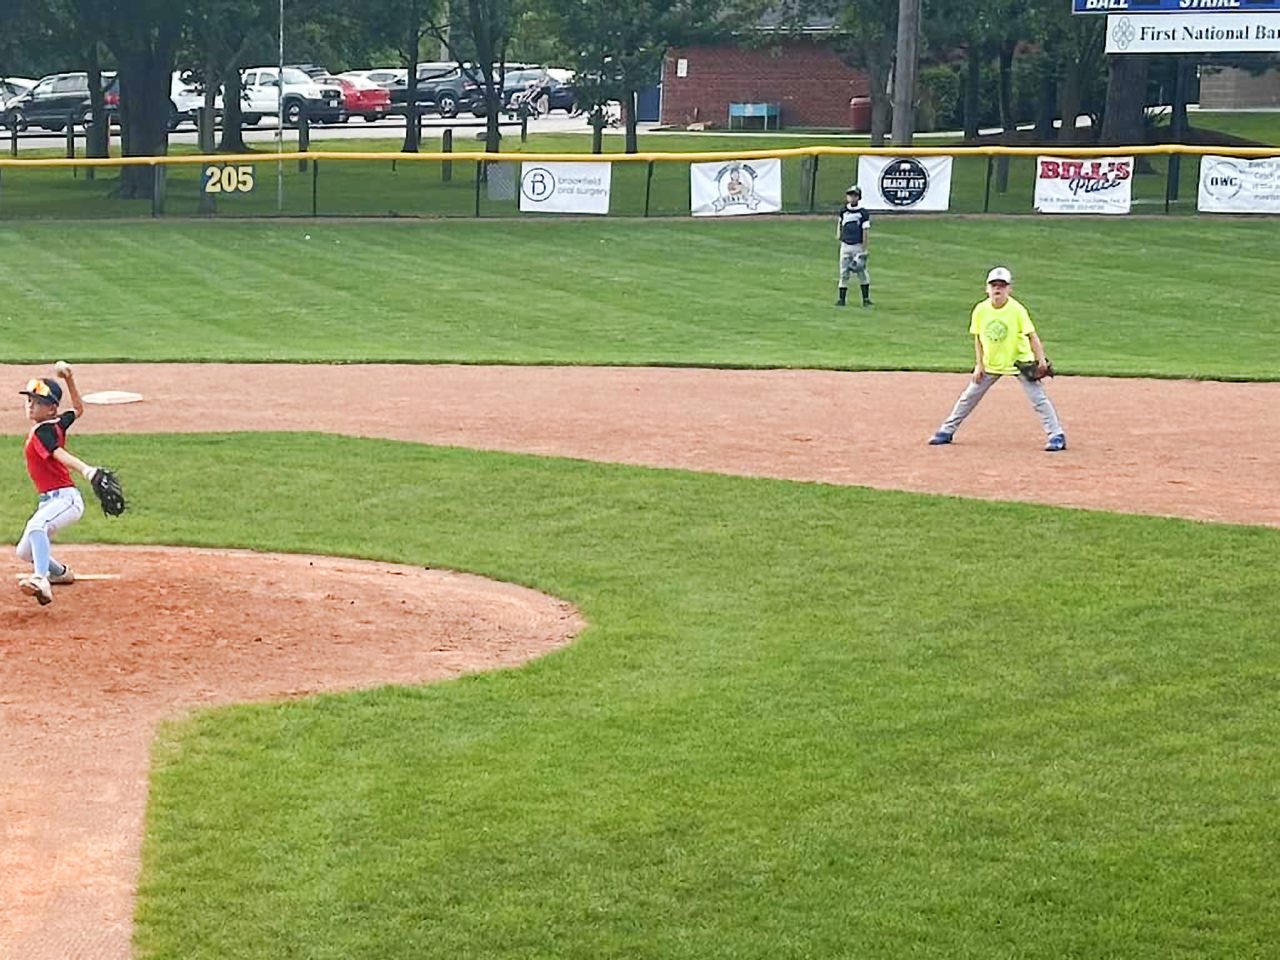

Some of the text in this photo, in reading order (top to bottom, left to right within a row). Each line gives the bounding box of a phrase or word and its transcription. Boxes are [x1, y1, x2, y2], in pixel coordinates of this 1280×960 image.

[1139, 26, 1176, 41] First
[1182, 25, 1249, 41] National
[205, 166, 254, 193] 205
[1040, 161, 1131, 180] BILL'S
[557, 186, 608, 197] oral surgery
[1069, 173, 1121, 196] Place
